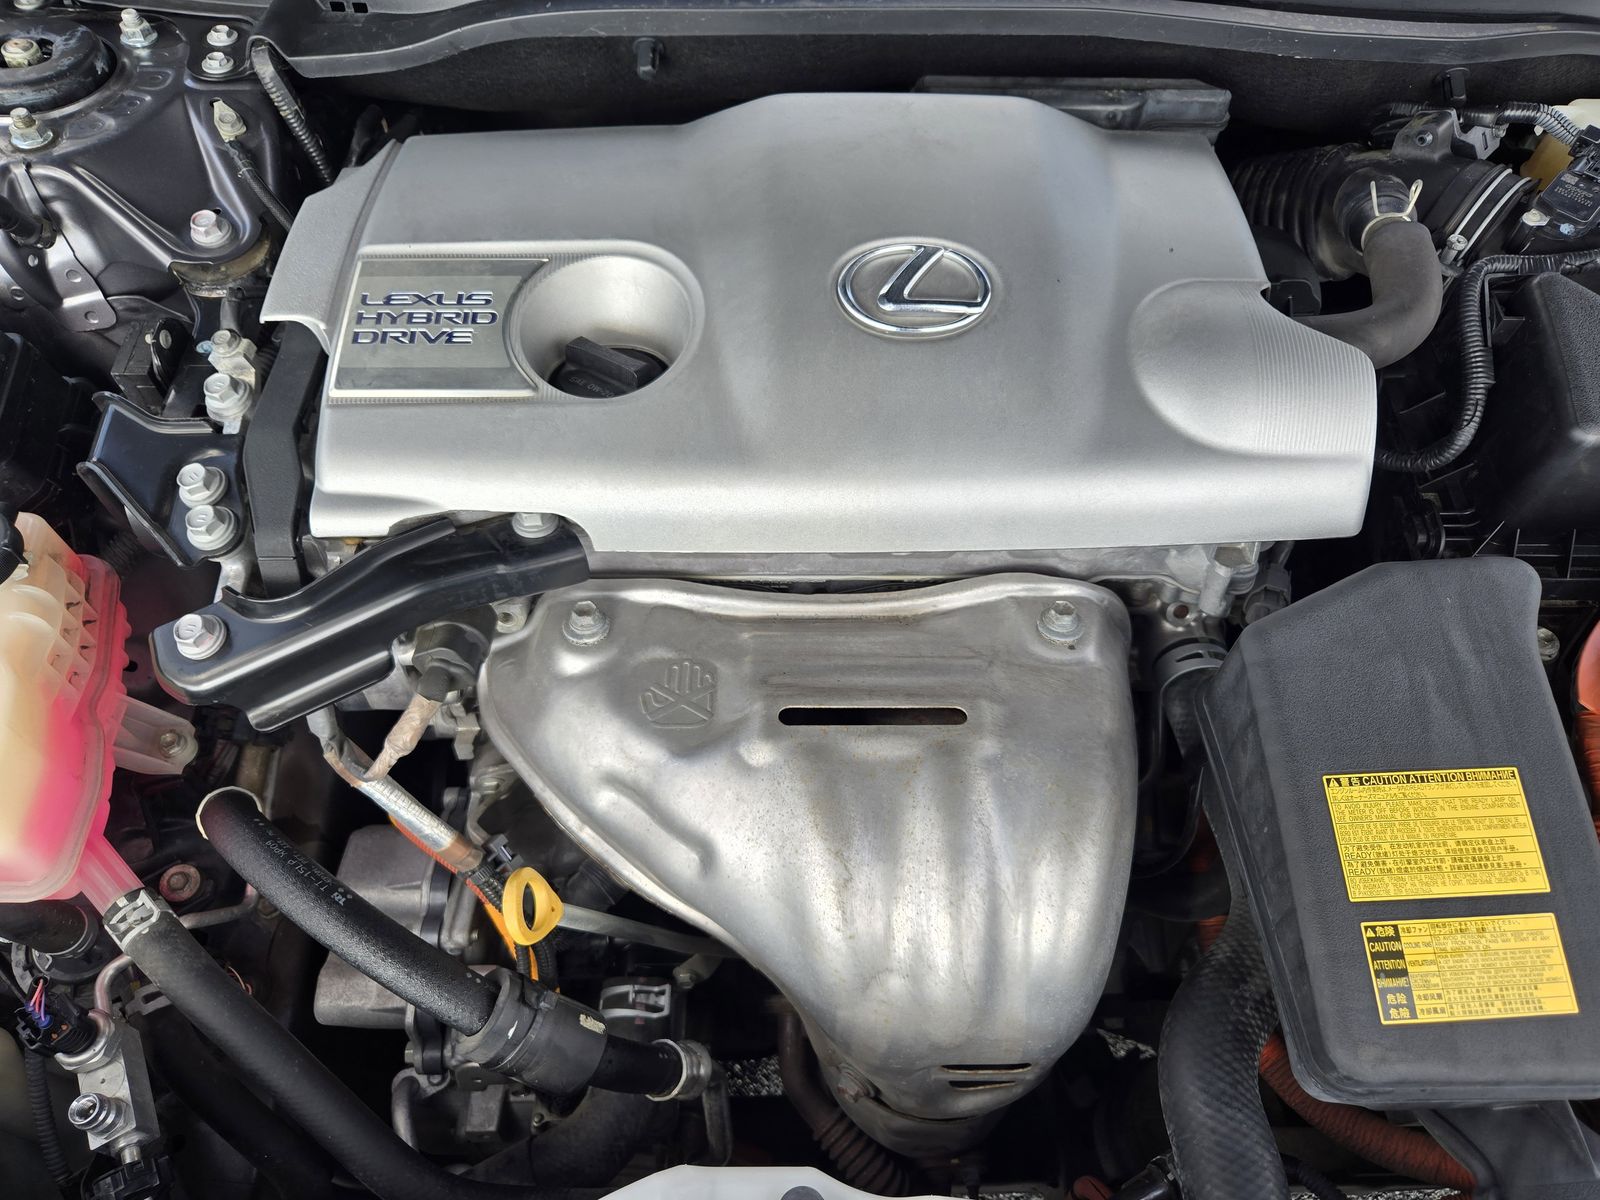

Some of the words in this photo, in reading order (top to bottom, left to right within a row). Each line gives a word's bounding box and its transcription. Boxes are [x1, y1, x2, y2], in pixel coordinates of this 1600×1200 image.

[361, 291, 493, 306] LEXUS
[356, 309, 498, 325] HYBRID
[352, 328, 474, 344] DRIVE
[1361, 774, 1407, 785] CAUTION
[1408, 772, 1465, 783] ATTENTION
[1465, 770, 1514, 780] ВНИМАНИЕ
[1368, 940, 1402, 952] CAUTION
[1372, 958, 1406, 970] ATTENTION
